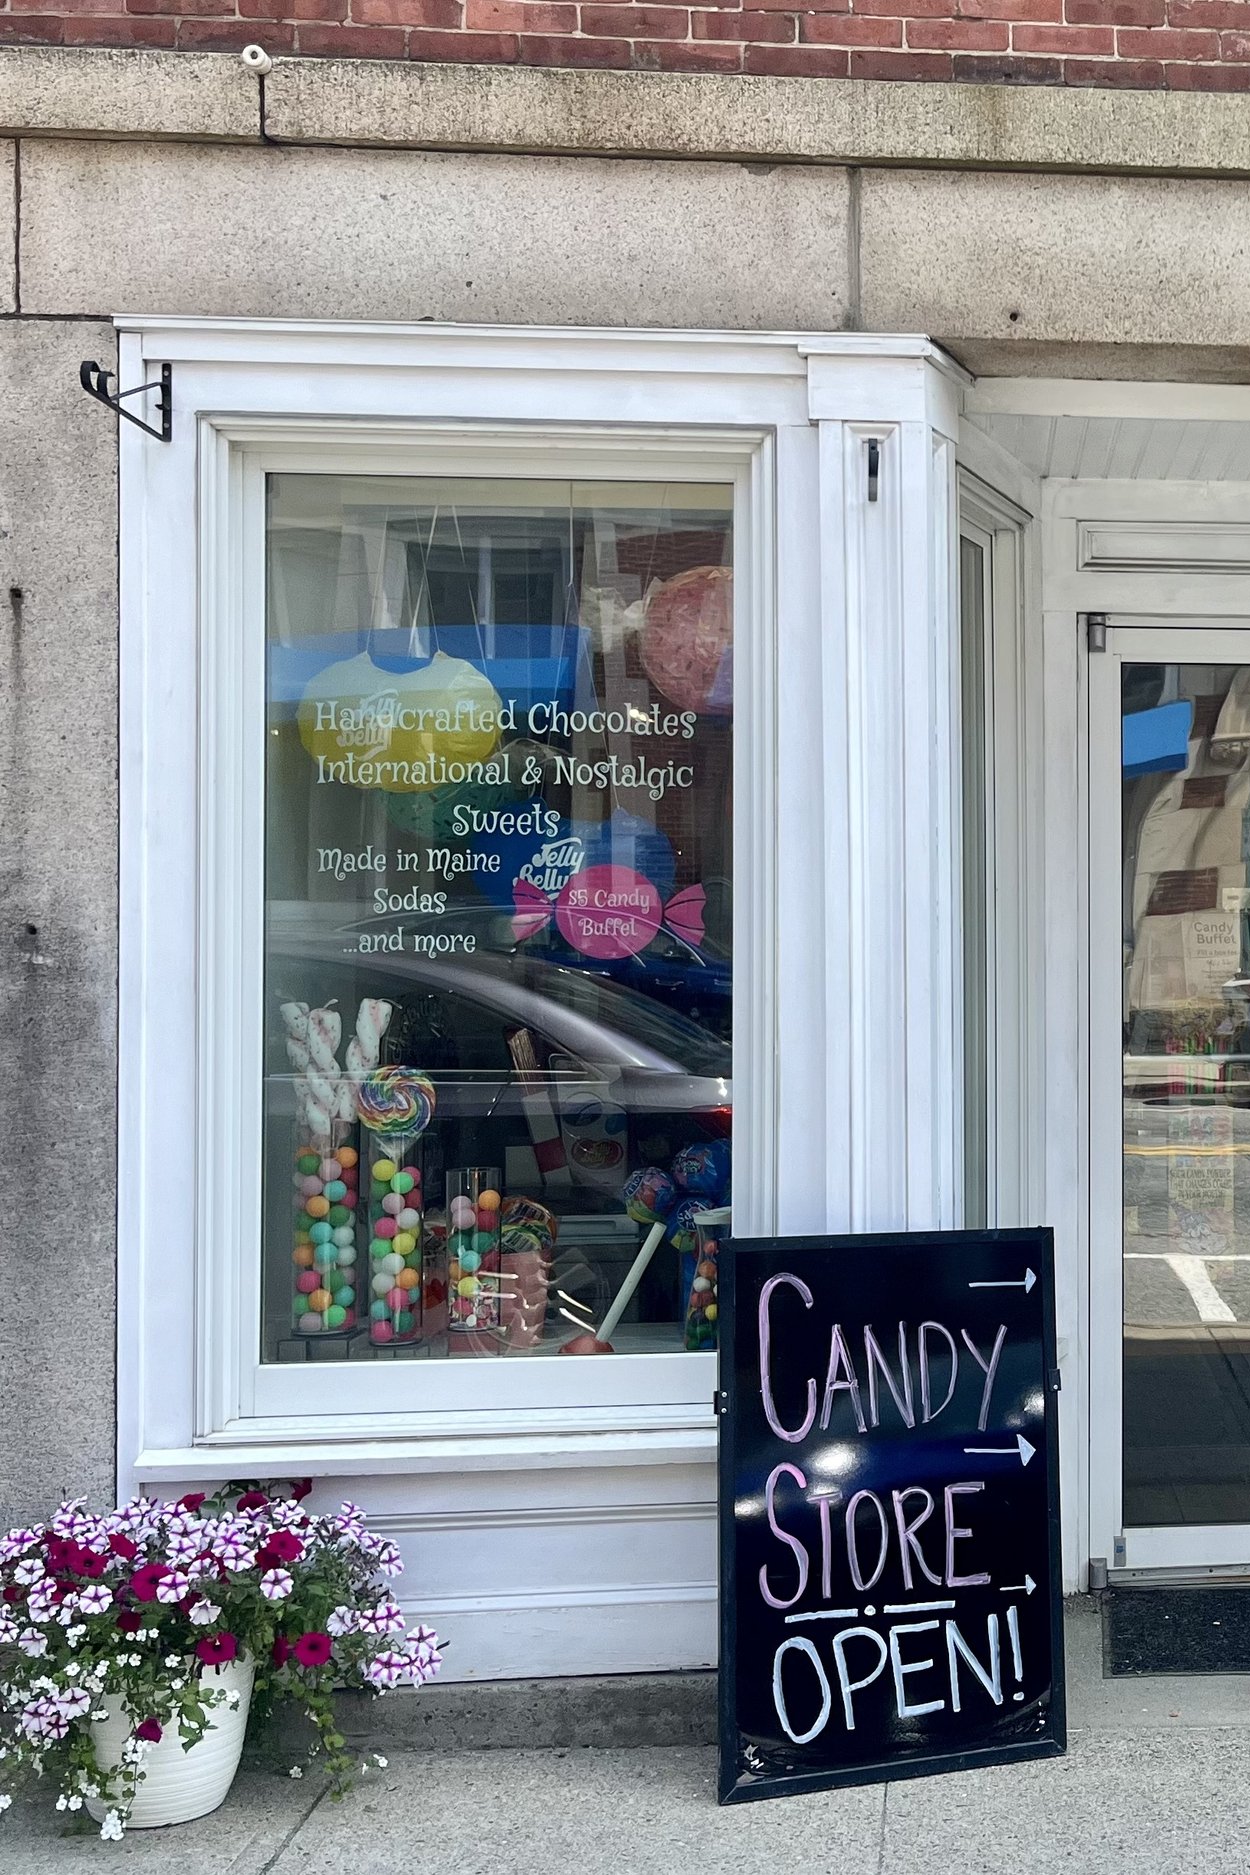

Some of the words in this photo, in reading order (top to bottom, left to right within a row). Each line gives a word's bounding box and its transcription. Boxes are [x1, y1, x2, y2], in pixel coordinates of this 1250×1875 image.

[314, 700, 517, 733] Handcrafted
[528, 700, 697, 739] Chocolates
[316, 752, 511, 785] International
[521, 756, 542, 785] &
[553, 755, 694, 800] Nostalgic
[452, 803, 561, 837] Sweets
[317, 845, 387, 881] Made
[396, 849, 420, 872] in
[426, 847, 501, 881] Maine
[532, 837, 586, 874] Jelly
[373, 886, 448, 914] Sodas
[594, 888, 650, 915] Candy
[578, 918, 639, 937] Buffet
[1194, 922, 1233, 935] Candy
[1197, 934, 1237, 944] Buffet
[414, 934, 476, 959] more
[758, 1272, 1008, 1443] CANDY
[759, 1462, 991, 1609] STORE
[773, 1605, 1024, 1744] OPEN!
